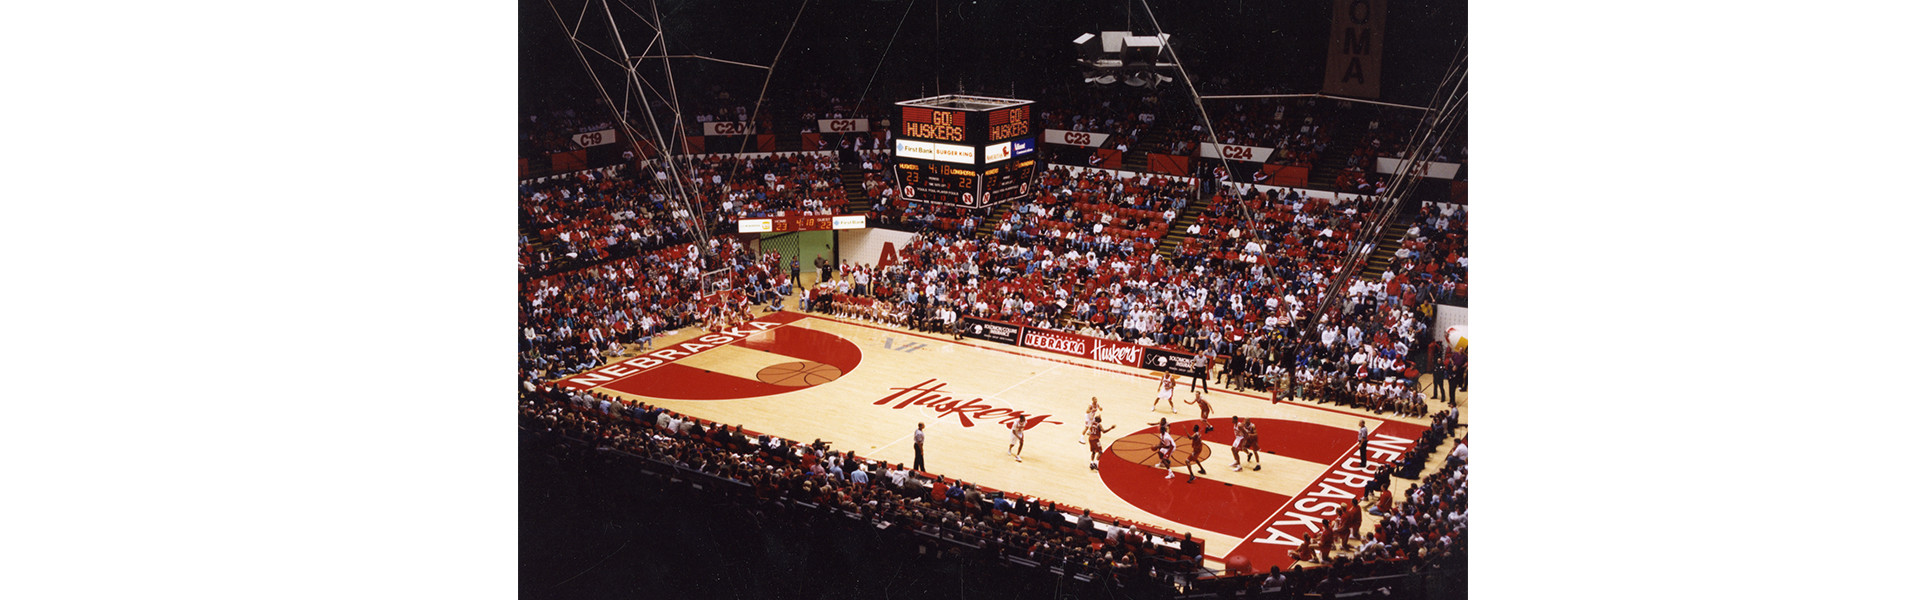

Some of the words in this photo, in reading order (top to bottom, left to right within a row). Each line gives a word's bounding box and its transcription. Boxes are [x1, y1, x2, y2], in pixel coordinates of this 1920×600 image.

[714, 122, 744, 134] C20
[830, 120, 856, 131] C21
[907, 122, 962, 141] HUSKERS
[992, 120, 1028, 140] HUSKERS
[580, 132, 602, 147] C19
[1064, 131, 1091, 145] C23
[904, 145, 918, 153] First
[936, 148, 958, 156] BURGER
[1222, 145, 1253, 160] C24
[906, 171, 919, 183] 23
[958, 176, 972, 189] 22
[878, 241, 900, 271] A
[1024, 333, 1086, 355] NEBRASKA
[1090, 338, 1140, 365] Huskers
[569, 321, 782, 387] NEBRASKA
[873, 378, 1064, 431] Huskers
[1252, 433, 1415, 547] NEBRASKA
